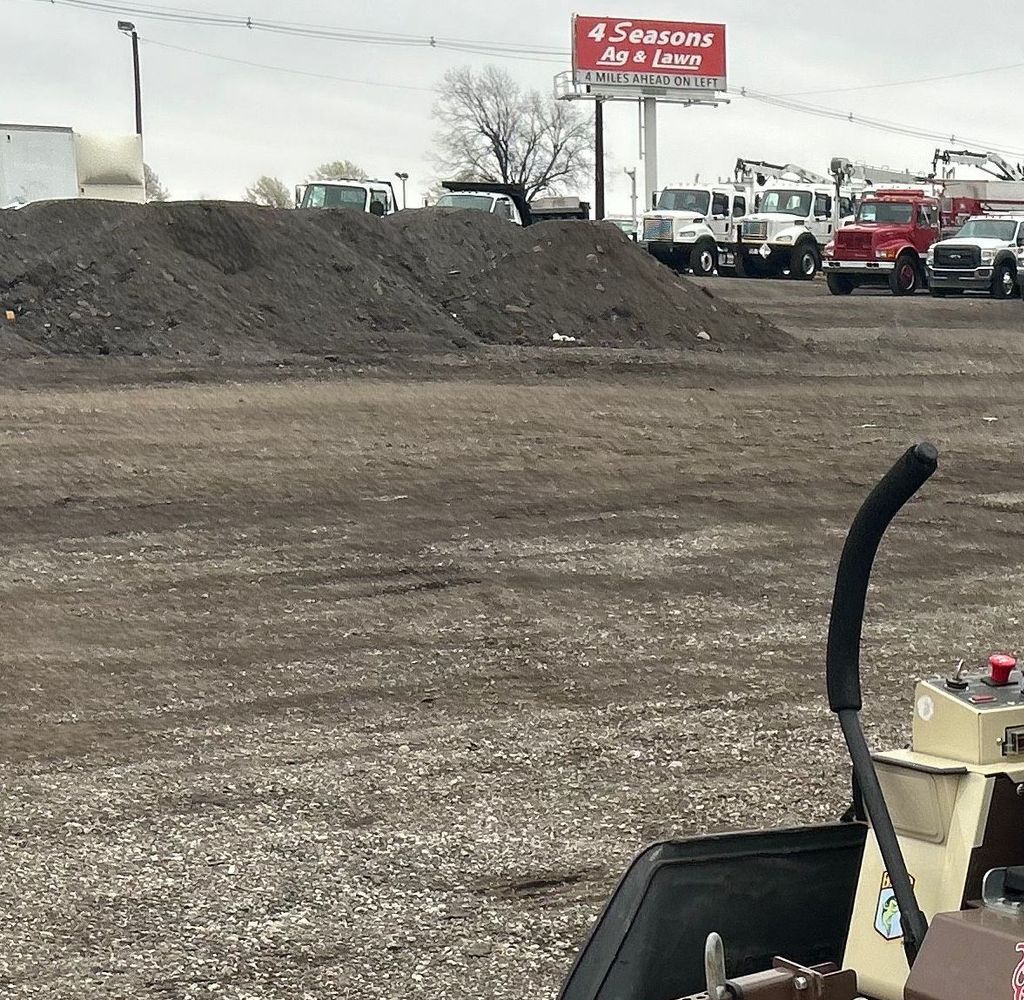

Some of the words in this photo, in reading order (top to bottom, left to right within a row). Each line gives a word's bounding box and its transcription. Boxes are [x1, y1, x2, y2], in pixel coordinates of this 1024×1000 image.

[588, 23, 607, 42] 4
[608, 22, 715, 48] Seasons
[596, 46, 629, 66] Ag
[633, 50, 647, 64] &
[652, 48, 703, 70] Lawn
[585, 72, 592, 82] 4
[595, 72, 629, 84] MILES
[632, 74, 671, 86] AHEAD
[674, 76, 690, 87] ON
[694, 77, 718, 88] LEFT
